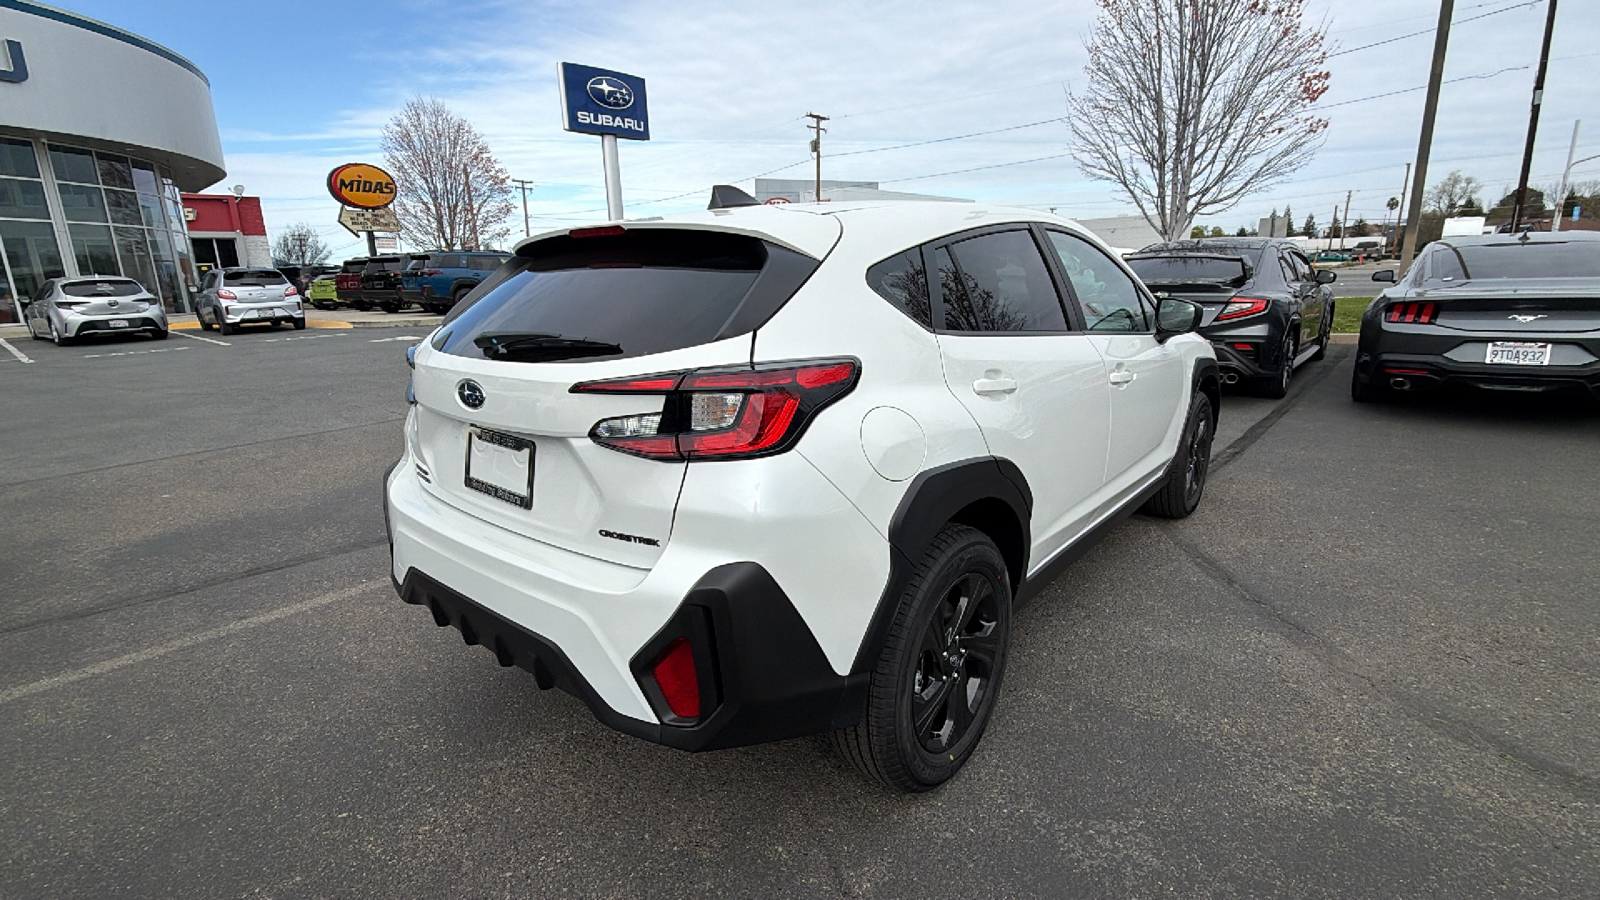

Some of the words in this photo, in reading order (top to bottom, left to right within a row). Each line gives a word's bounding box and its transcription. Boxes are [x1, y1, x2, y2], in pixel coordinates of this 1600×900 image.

[576, 111, 644, 132] SUBARU
[339, 176, 394, 194] MIDAS
[598, 529, 660, 547] CROSSTREK
